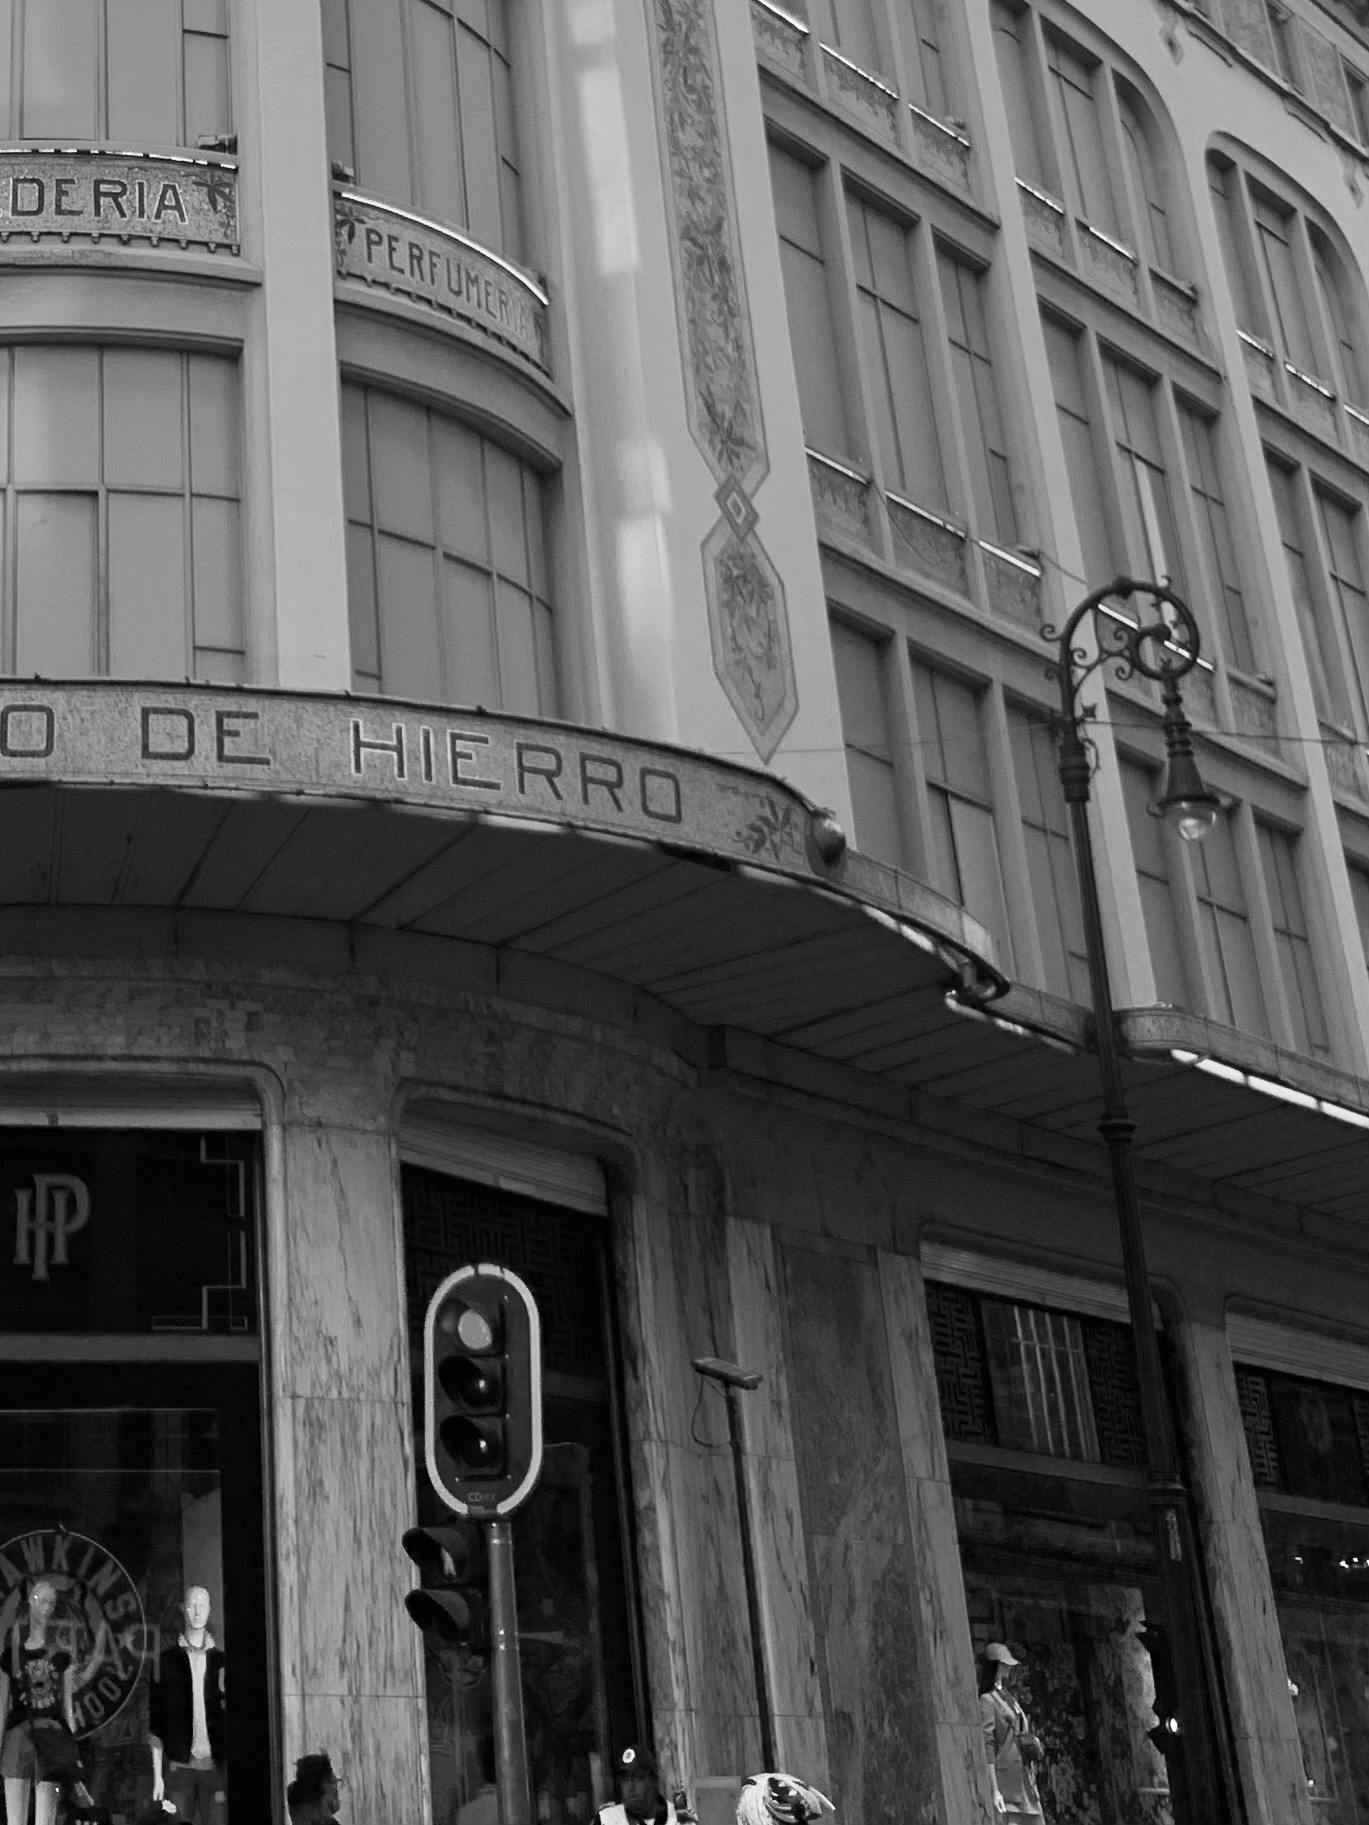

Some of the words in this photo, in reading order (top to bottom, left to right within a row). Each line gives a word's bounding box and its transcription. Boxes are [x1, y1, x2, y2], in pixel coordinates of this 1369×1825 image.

[363, 227, 530, 339] PERFUMERIA
[140, 705, 272, 766] DE
[349, 718, 683, 824] HIERRO
